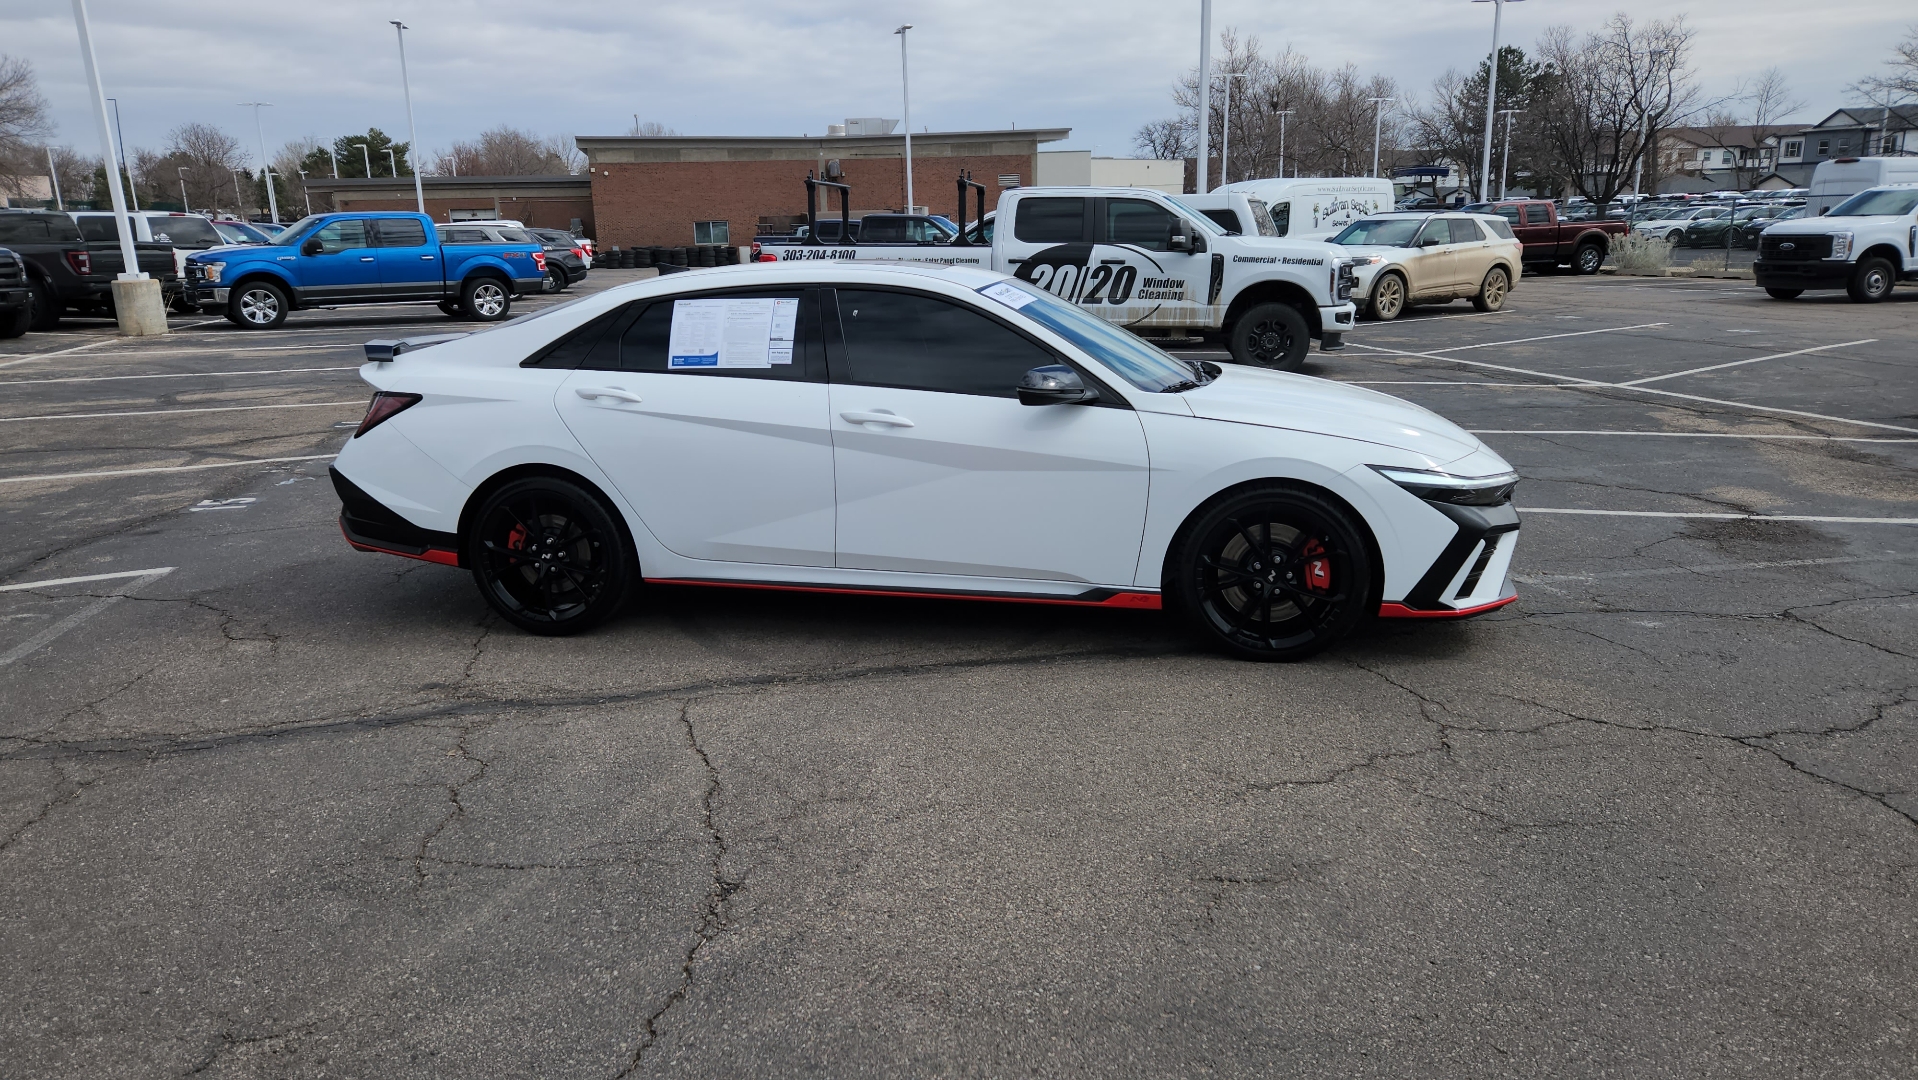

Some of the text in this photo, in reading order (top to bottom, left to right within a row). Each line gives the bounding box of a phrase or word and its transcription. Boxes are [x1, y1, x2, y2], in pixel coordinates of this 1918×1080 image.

[782, 249, 857, 261] 303-204-8100
[955, 257, 980, 265] Cleaning
[1232, 254, 1324, 266] Commercial Residential
[1142, 277, 1185, 289] Window
[1138, 289, 1185, 301] Cleaning
